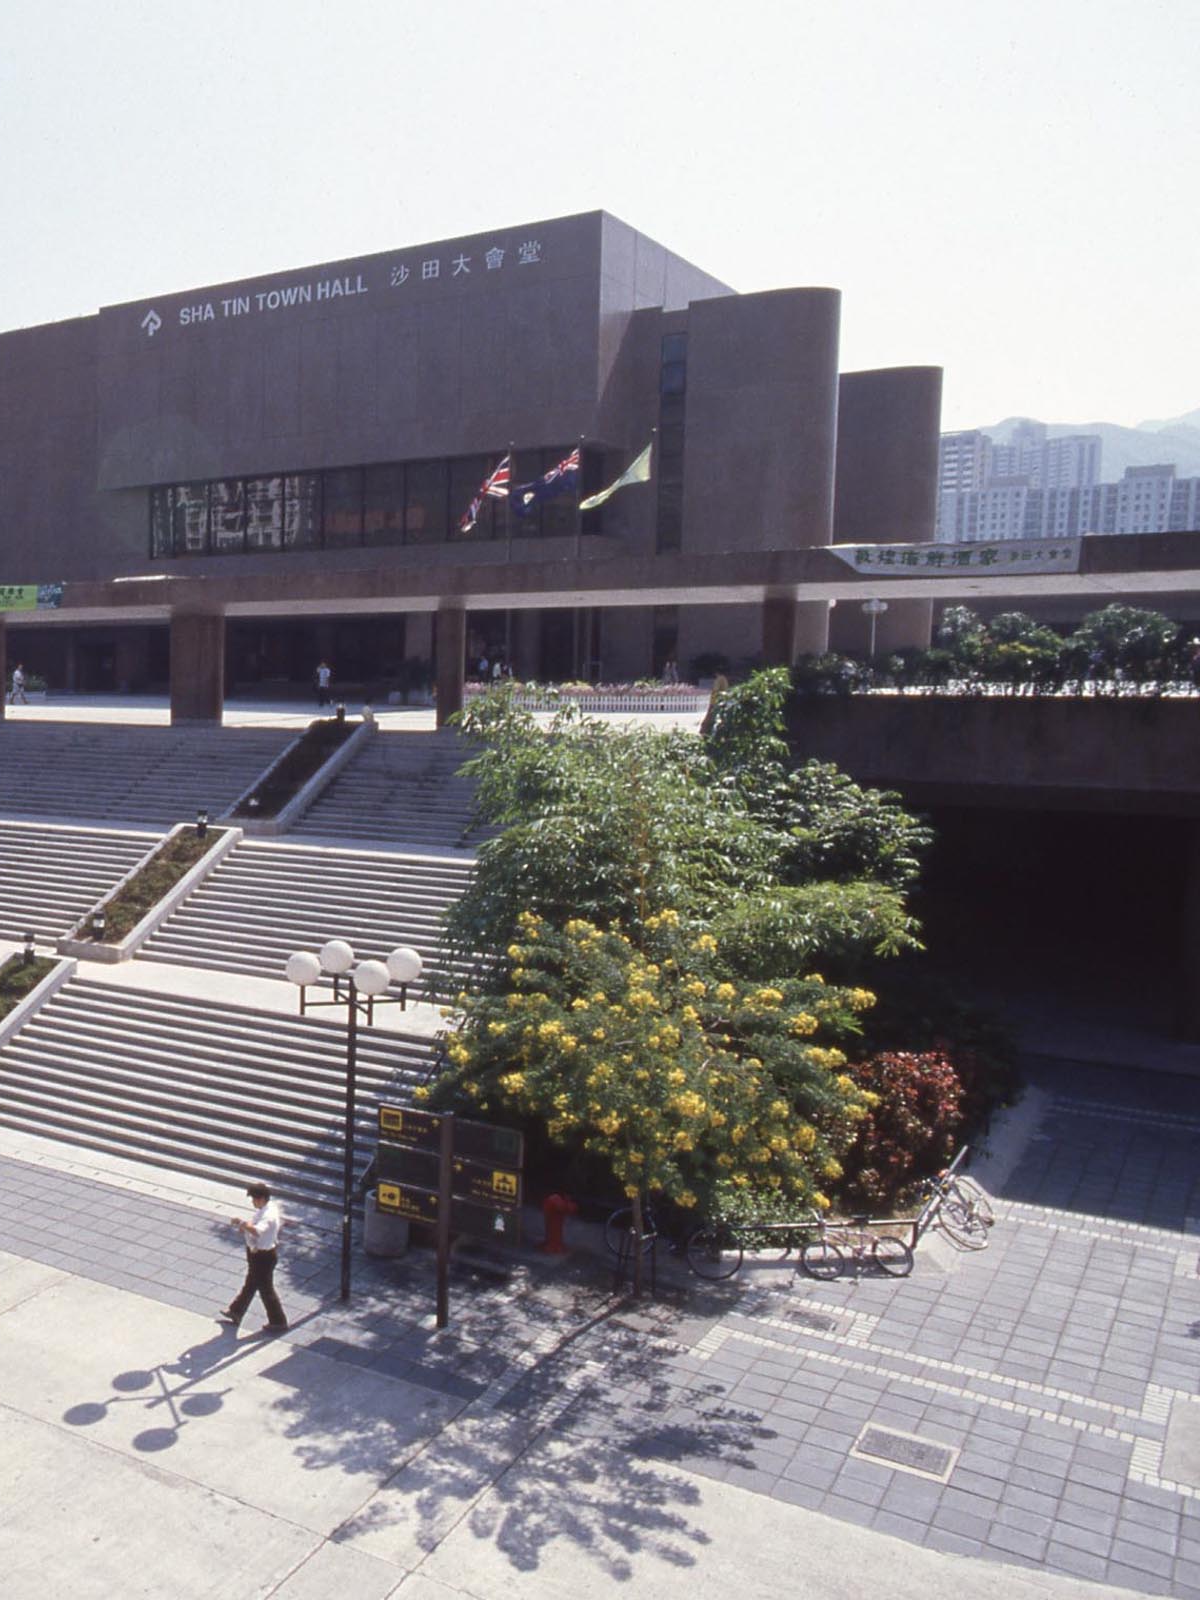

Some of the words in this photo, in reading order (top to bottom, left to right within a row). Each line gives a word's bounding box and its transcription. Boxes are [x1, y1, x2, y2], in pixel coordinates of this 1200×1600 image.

[390, 240, 541, 287] 沙田大會堂
[179, 303, 215, 326] SHA
[222, 296, 250, 316] TIN
[255, 284, 313, 312] TOWN
[316, 275, 369, 302] HALL
